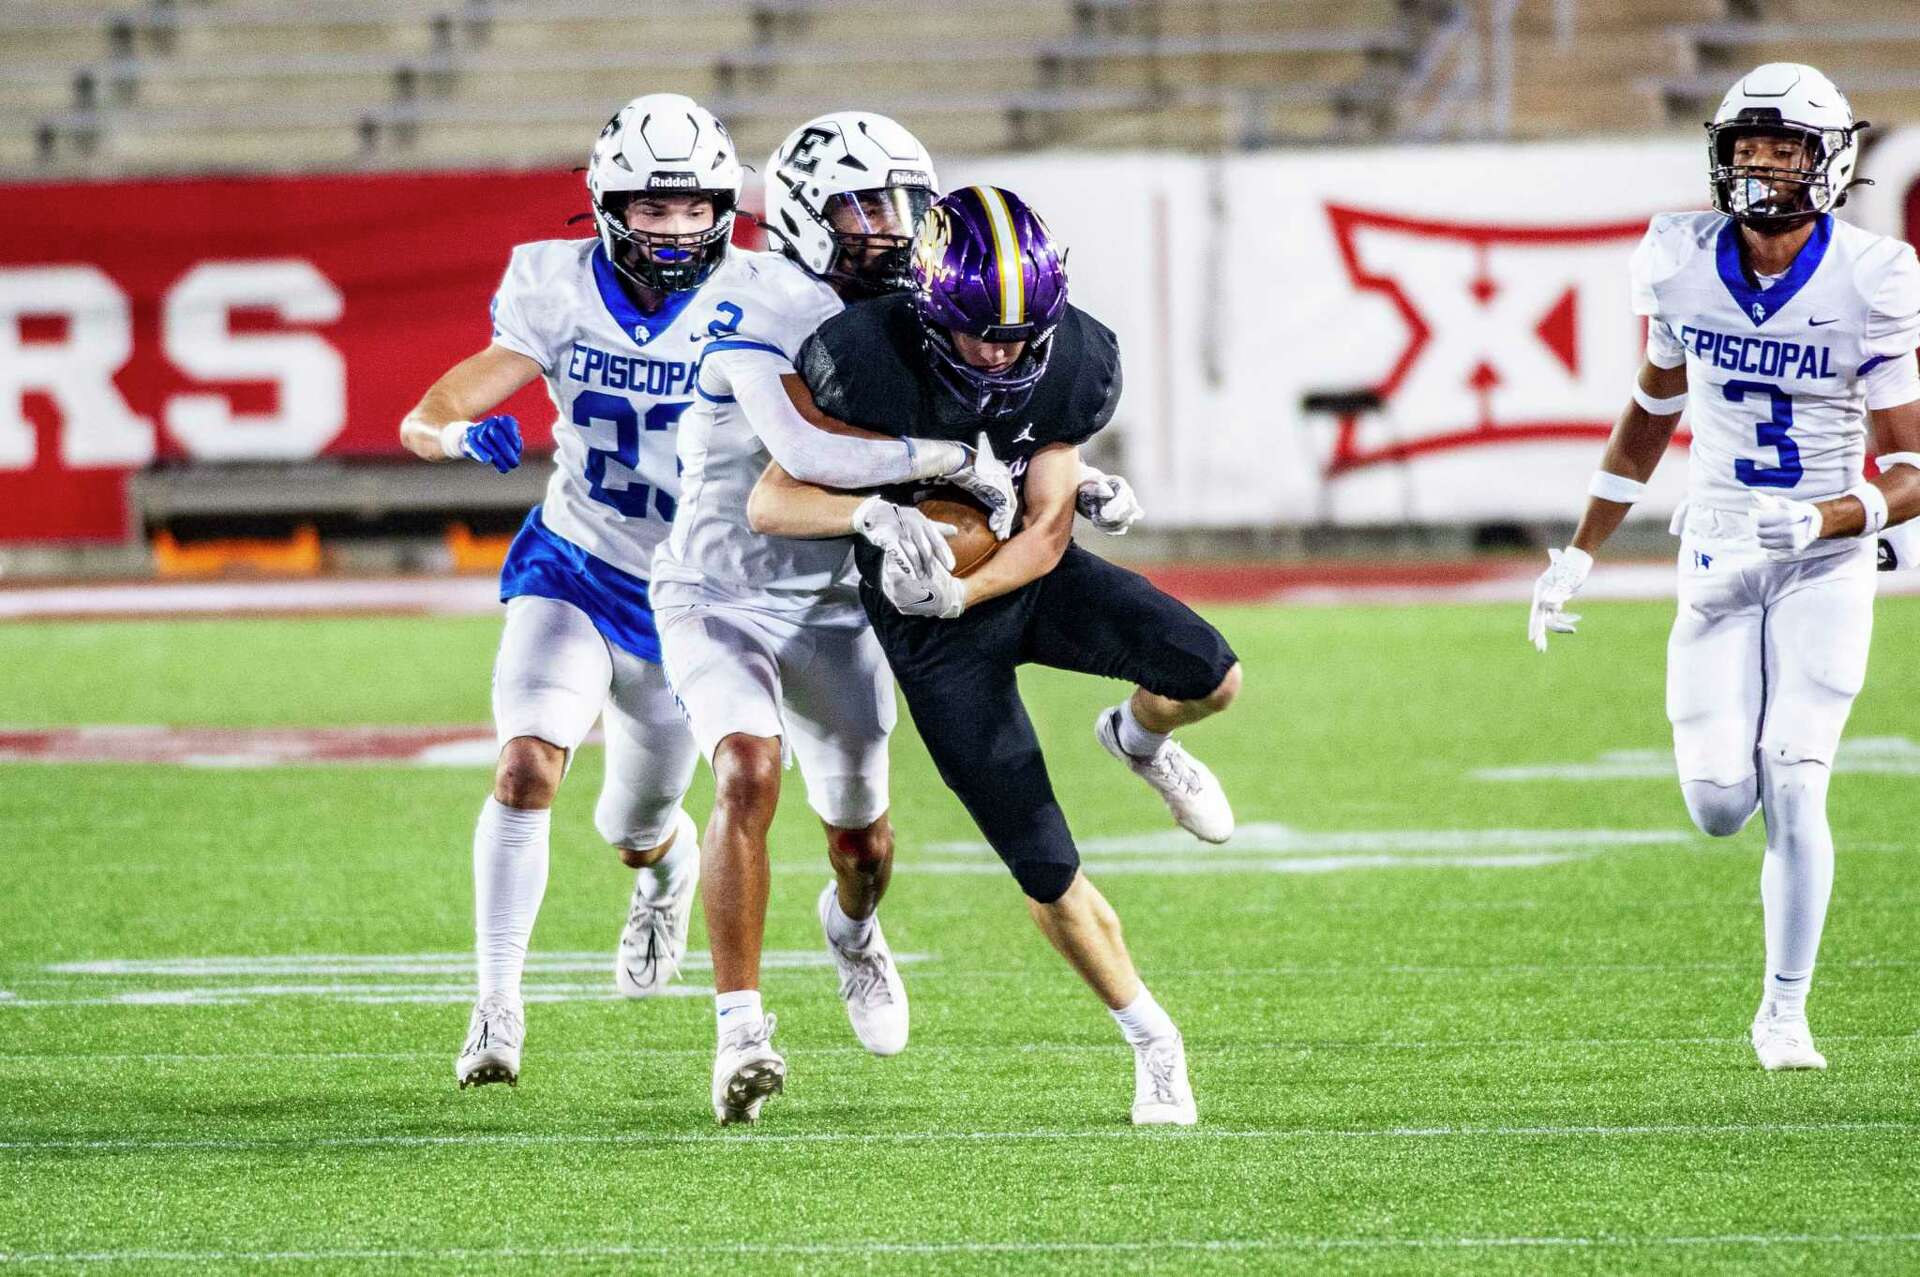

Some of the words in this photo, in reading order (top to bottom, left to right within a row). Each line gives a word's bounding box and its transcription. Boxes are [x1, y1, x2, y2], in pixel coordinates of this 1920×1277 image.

[785, 127, 840, 177] E
[650, 176, 697, 188] Riddell
[891, 173, 930, 186] Riddell
[707, 300, 744, 338] 2
[568, 342, 700, 397] EPISCOPA
[1681, 325, 1837, 379] EPISCOPAL
[1722, 379, 1804, 488] 3
